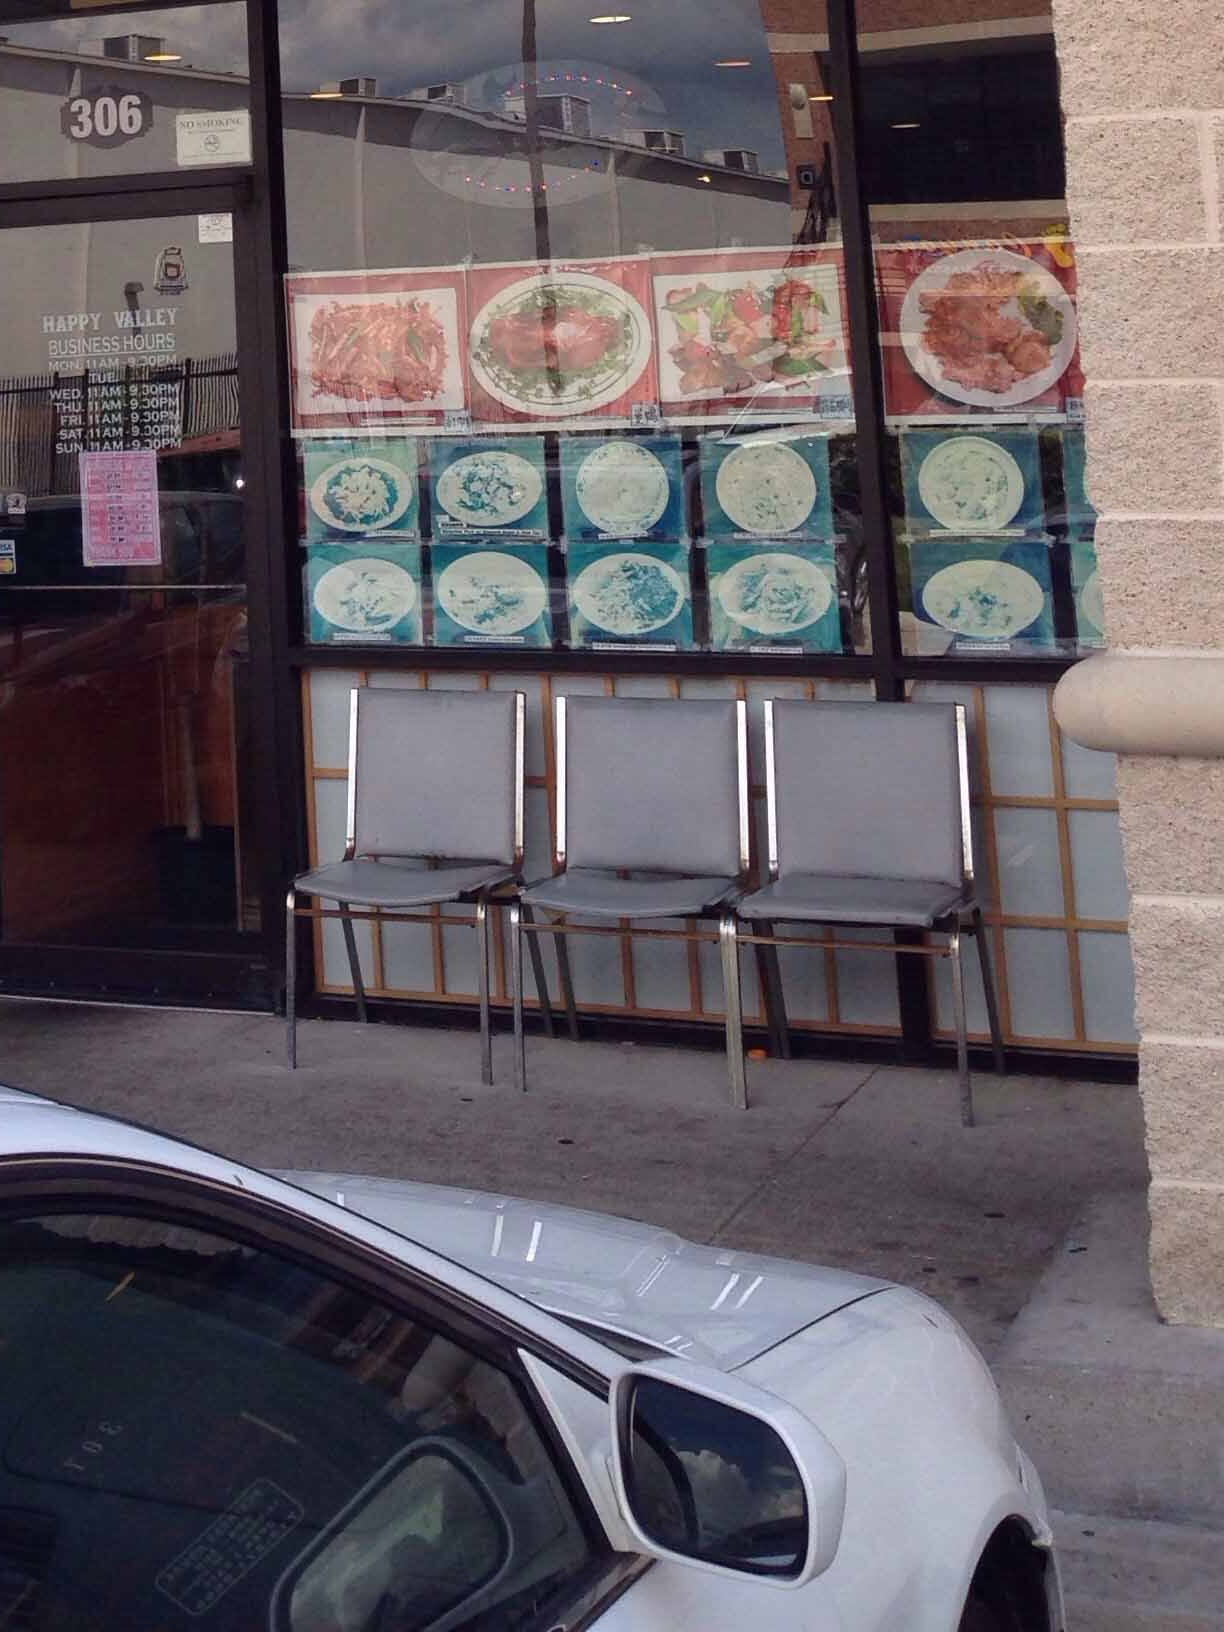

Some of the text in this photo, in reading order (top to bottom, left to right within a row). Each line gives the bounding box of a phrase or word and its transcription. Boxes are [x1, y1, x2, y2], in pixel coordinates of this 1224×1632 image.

[69, 94, 143, 139] 306
[40, 307, 179, 333] HAPPY VALLEY
[48, 332, 176, 356] BUSINESS HOURS
